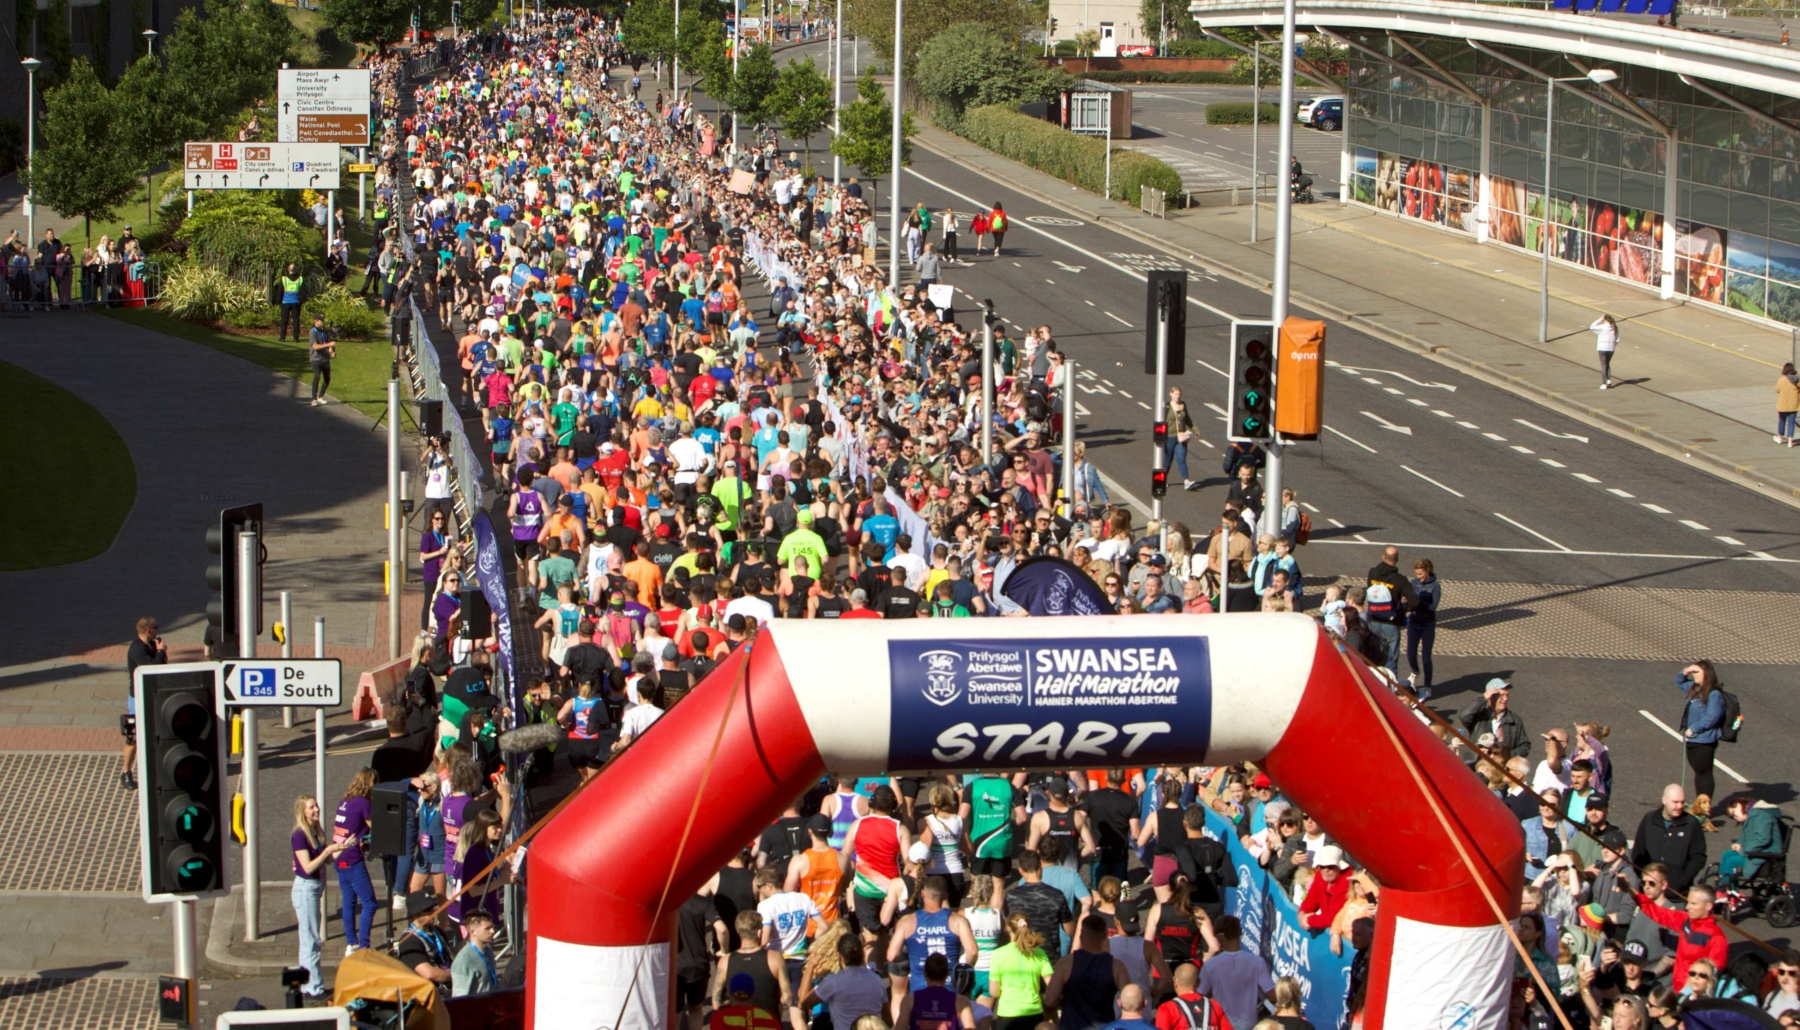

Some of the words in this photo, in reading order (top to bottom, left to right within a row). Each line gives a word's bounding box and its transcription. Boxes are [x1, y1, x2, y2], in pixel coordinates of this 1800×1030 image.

[221, 145, 230, 156] H
[293, 163, 300, 172] P
[792, 547, 813, 555] 1:45
[968, 651, 1019, 664] Prifysgol
[1035, 648, 1177, 673] SWANSEA
[284, 667, 305, 680] De
[967, 662, 1023, 673] Abertawe
[244, 670, 264, 695] P
[968, 680, 1022, 692] Swansea
[253, 687, 273, 695] 345
[283, 684, 333, 697] South
[968, 693, 1023, 706] University
[1035, 696, 1073, 707] HANNER
[1074, 696, 1126, 706] MARATHON
[1128, 695, 1177, 705] ABERTAWE
[931, 721, 1171, 762] START
[917, 926, 949, 935] CHARL
